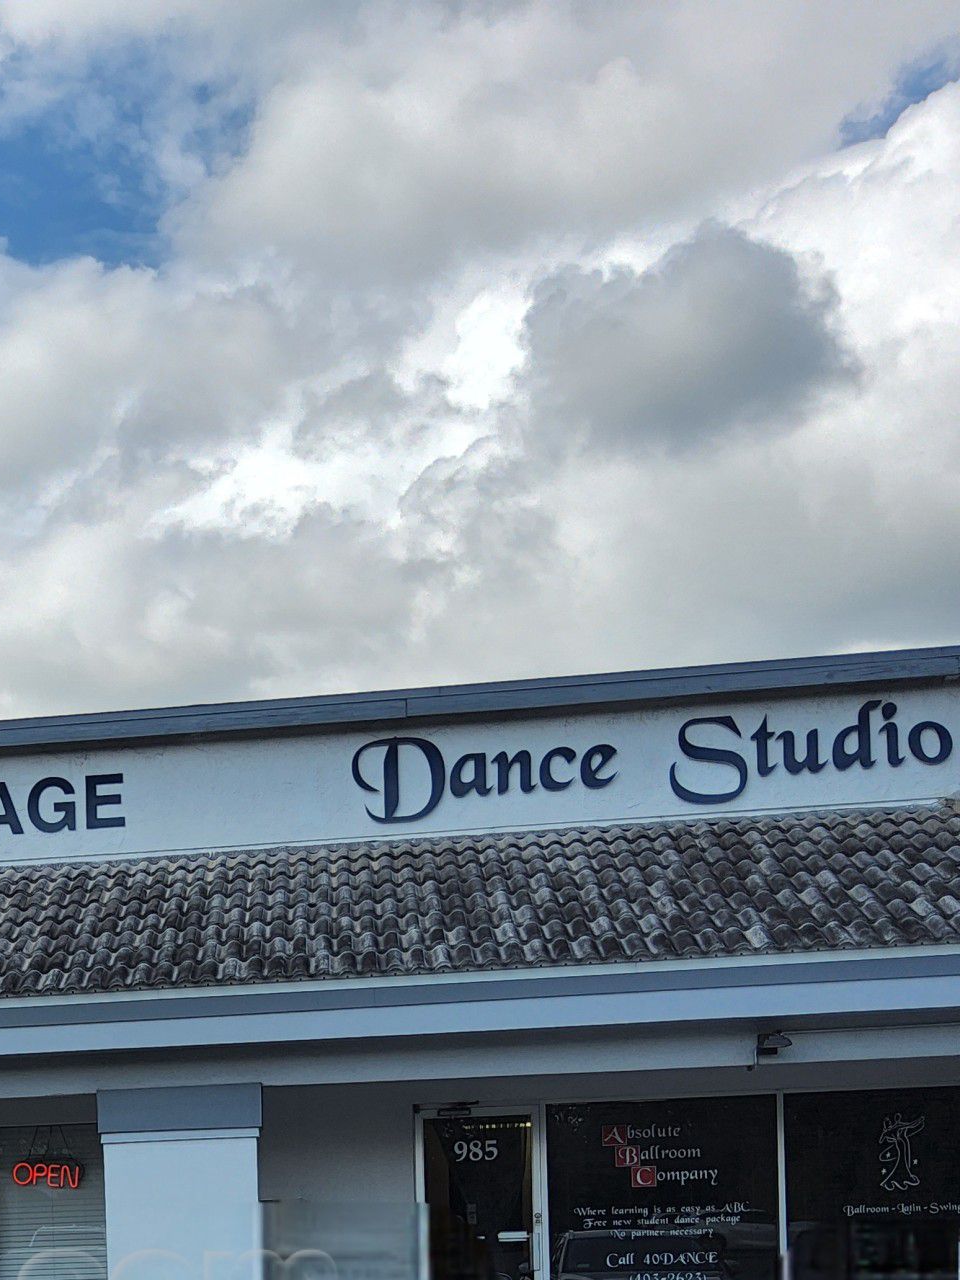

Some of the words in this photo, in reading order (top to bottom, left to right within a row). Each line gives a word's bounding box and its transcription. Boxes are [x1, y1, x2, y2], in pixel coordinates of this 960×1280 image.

[352, 735, 620, 825] Dance
[669, 700, 954, 805] Studio
[604, 1123, 682, 1144] Absolute
[454, 1140, 499, 1162] 985
[618, 1145, 702, 1167] Ballroom
[12, 1161, 80, 1189] OPEN
[635, 1167, 719, 1187] Company
[573, 1206, 607, 1217] Where
[611, 1205, 649, 1217] learning
[653, 1205, 662, 1214] is
[666, 1206, 676, 1214] as
[680, 1206, 701, 1216] easy
[706, 1205, 716, 1213] as
[583, 1218, 608, 1230] Free
[612, 1218, 632, 1226] new
[637, 1216, 670, 1226] student
[673, 1215, 700, 1225] dance
[705, 1214, 742, 1226] package
[610, 1229, 626, 1240] No
[631, 1229, 665, 1240] partner
[669, 1227, 714, 1239] necessary
[606, 1252, 635, 1268] Call
[643, 1251, 719, 1266] 40DANCE
